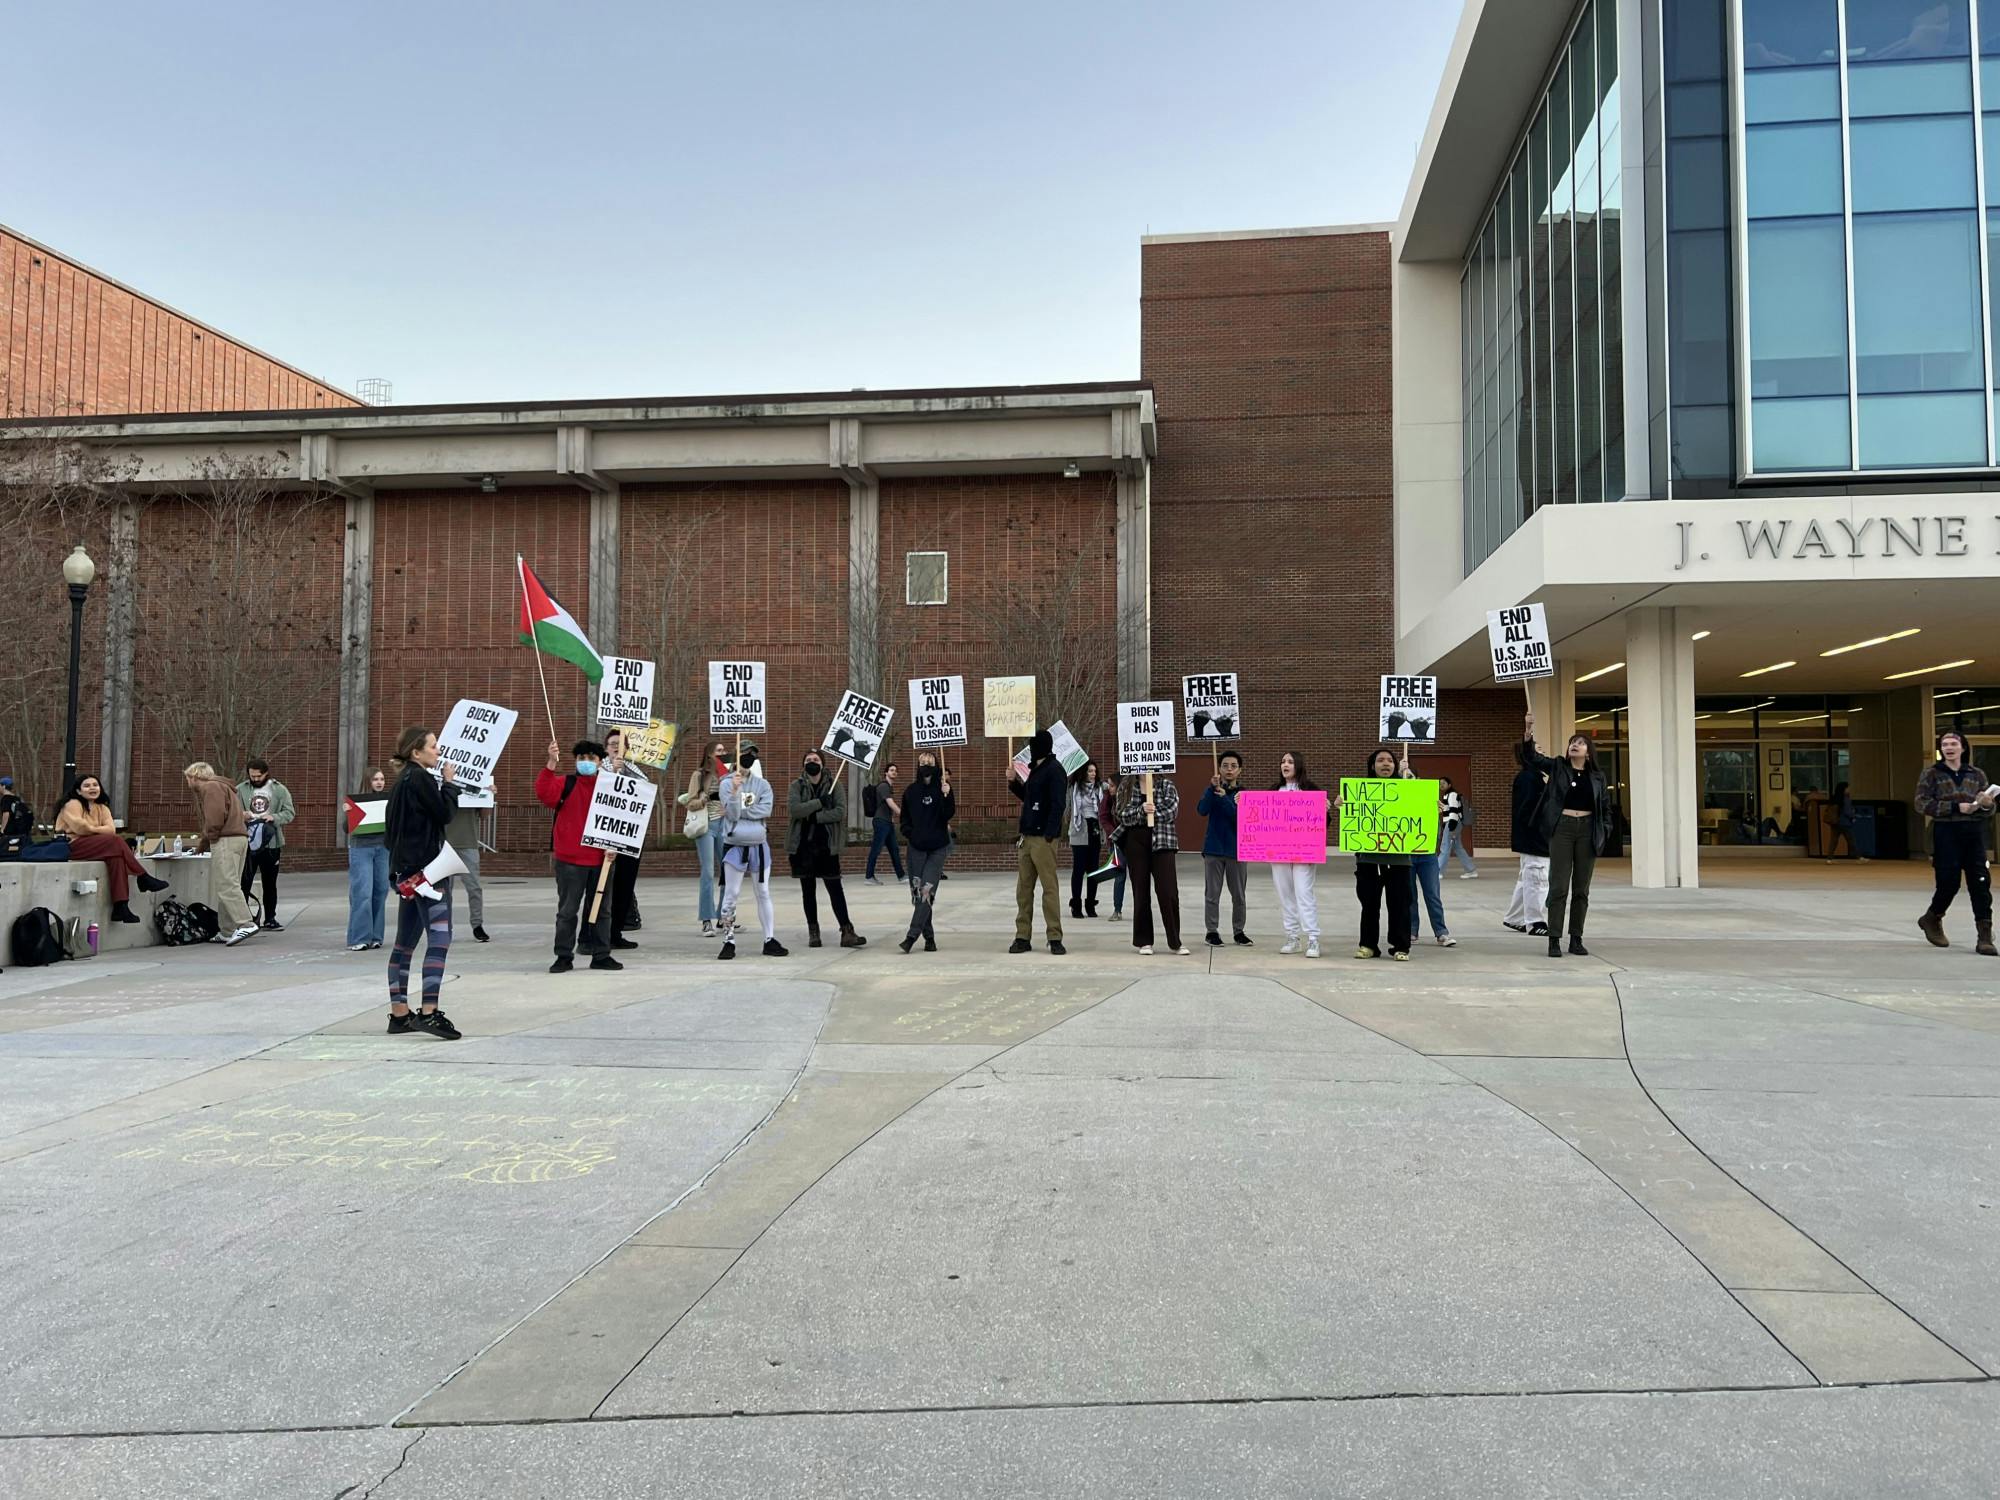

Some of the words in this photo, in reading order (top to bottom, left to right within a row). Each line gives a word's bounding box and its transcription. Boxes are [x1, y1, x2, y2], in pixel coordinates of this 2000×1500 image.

[1674, 521, 1710, 570] J.
[1736, 515, 1969, 559] WAYNE
[1500, 606, 1532, 627] END
[1505, 624, 1533, 643] ALL
[1494, 646, 1520, 662] U.S.
[1524, 642, 1546, 658] AID
[615, 659, 643, 677] END
[723, 664, 753, 681] END
[1495, 663, 1508, 674] TO
[1510, 657, 1549, 672] ISRAEL!
[615, 676, 639, 693] ALL
[725, 681, 751, 697] ALL
[922, 679, 950, 696] END
[988, 681, 1016, 693] STOP
[1187, 675, 1233, 697] FREE
[1386, 677, 1433, 697] FREE
[602, 692, 625, 707] U.S.
[628, 696, 648, 710] AID
[714, 699, 738, 713] U.S.
[741, 699, 762, 713] AID
[926, 695, 950, 711] ALL
[1185, 695, 1236, 708] PALESTINE
[1383, 697, 1435, 708] PALESTINE
[466, 706, 500, 725] BIDEN
[600, 707, 611, 717] TO
[614, 708, 648, 721] ISRAEL!
[844, 694, 889, 727] FREE
[1131, 706, 1160, 717] BIDEN
[713, 715, 724, 725] TO
[727, 715, 763, 725] ISRAEL!
[837, 710, 885, 738] PALESTINE
[915, 715, 938, 729] U.S.
[941, 713, 961, 727] AID
[1134, 721, 1159, 733] HAS
[460, 724, 489, 743] HAS
[915, 730, 927, 740] TO
[929, 727, 963, 739] ISRAEL!
[1123, 741, 1154, 752] BLOOD
[1157, 740, 1171, 751] ON
[440, 745, 471, 763] BLOOD
[472, 755, 491, 769] ON
[1124, 753, 1139, 763] HIS
[1141, 752, 1171, 762] HANDS
[454, 764, 484, 782] ANDS
[614, 776, 639, 797] U.S.
[1343, 782, 1399, 802] NAZIS
[595, 792, 627, 810] HANDS
[629, 801, 647, 815] OFF
[1343, 802, 1386, 817] THINK
[594, 814, 640, 839] YEMEN!
[1345, 832, 1362, 851] IS
[1364, 832, 1407, 852] SEXY
